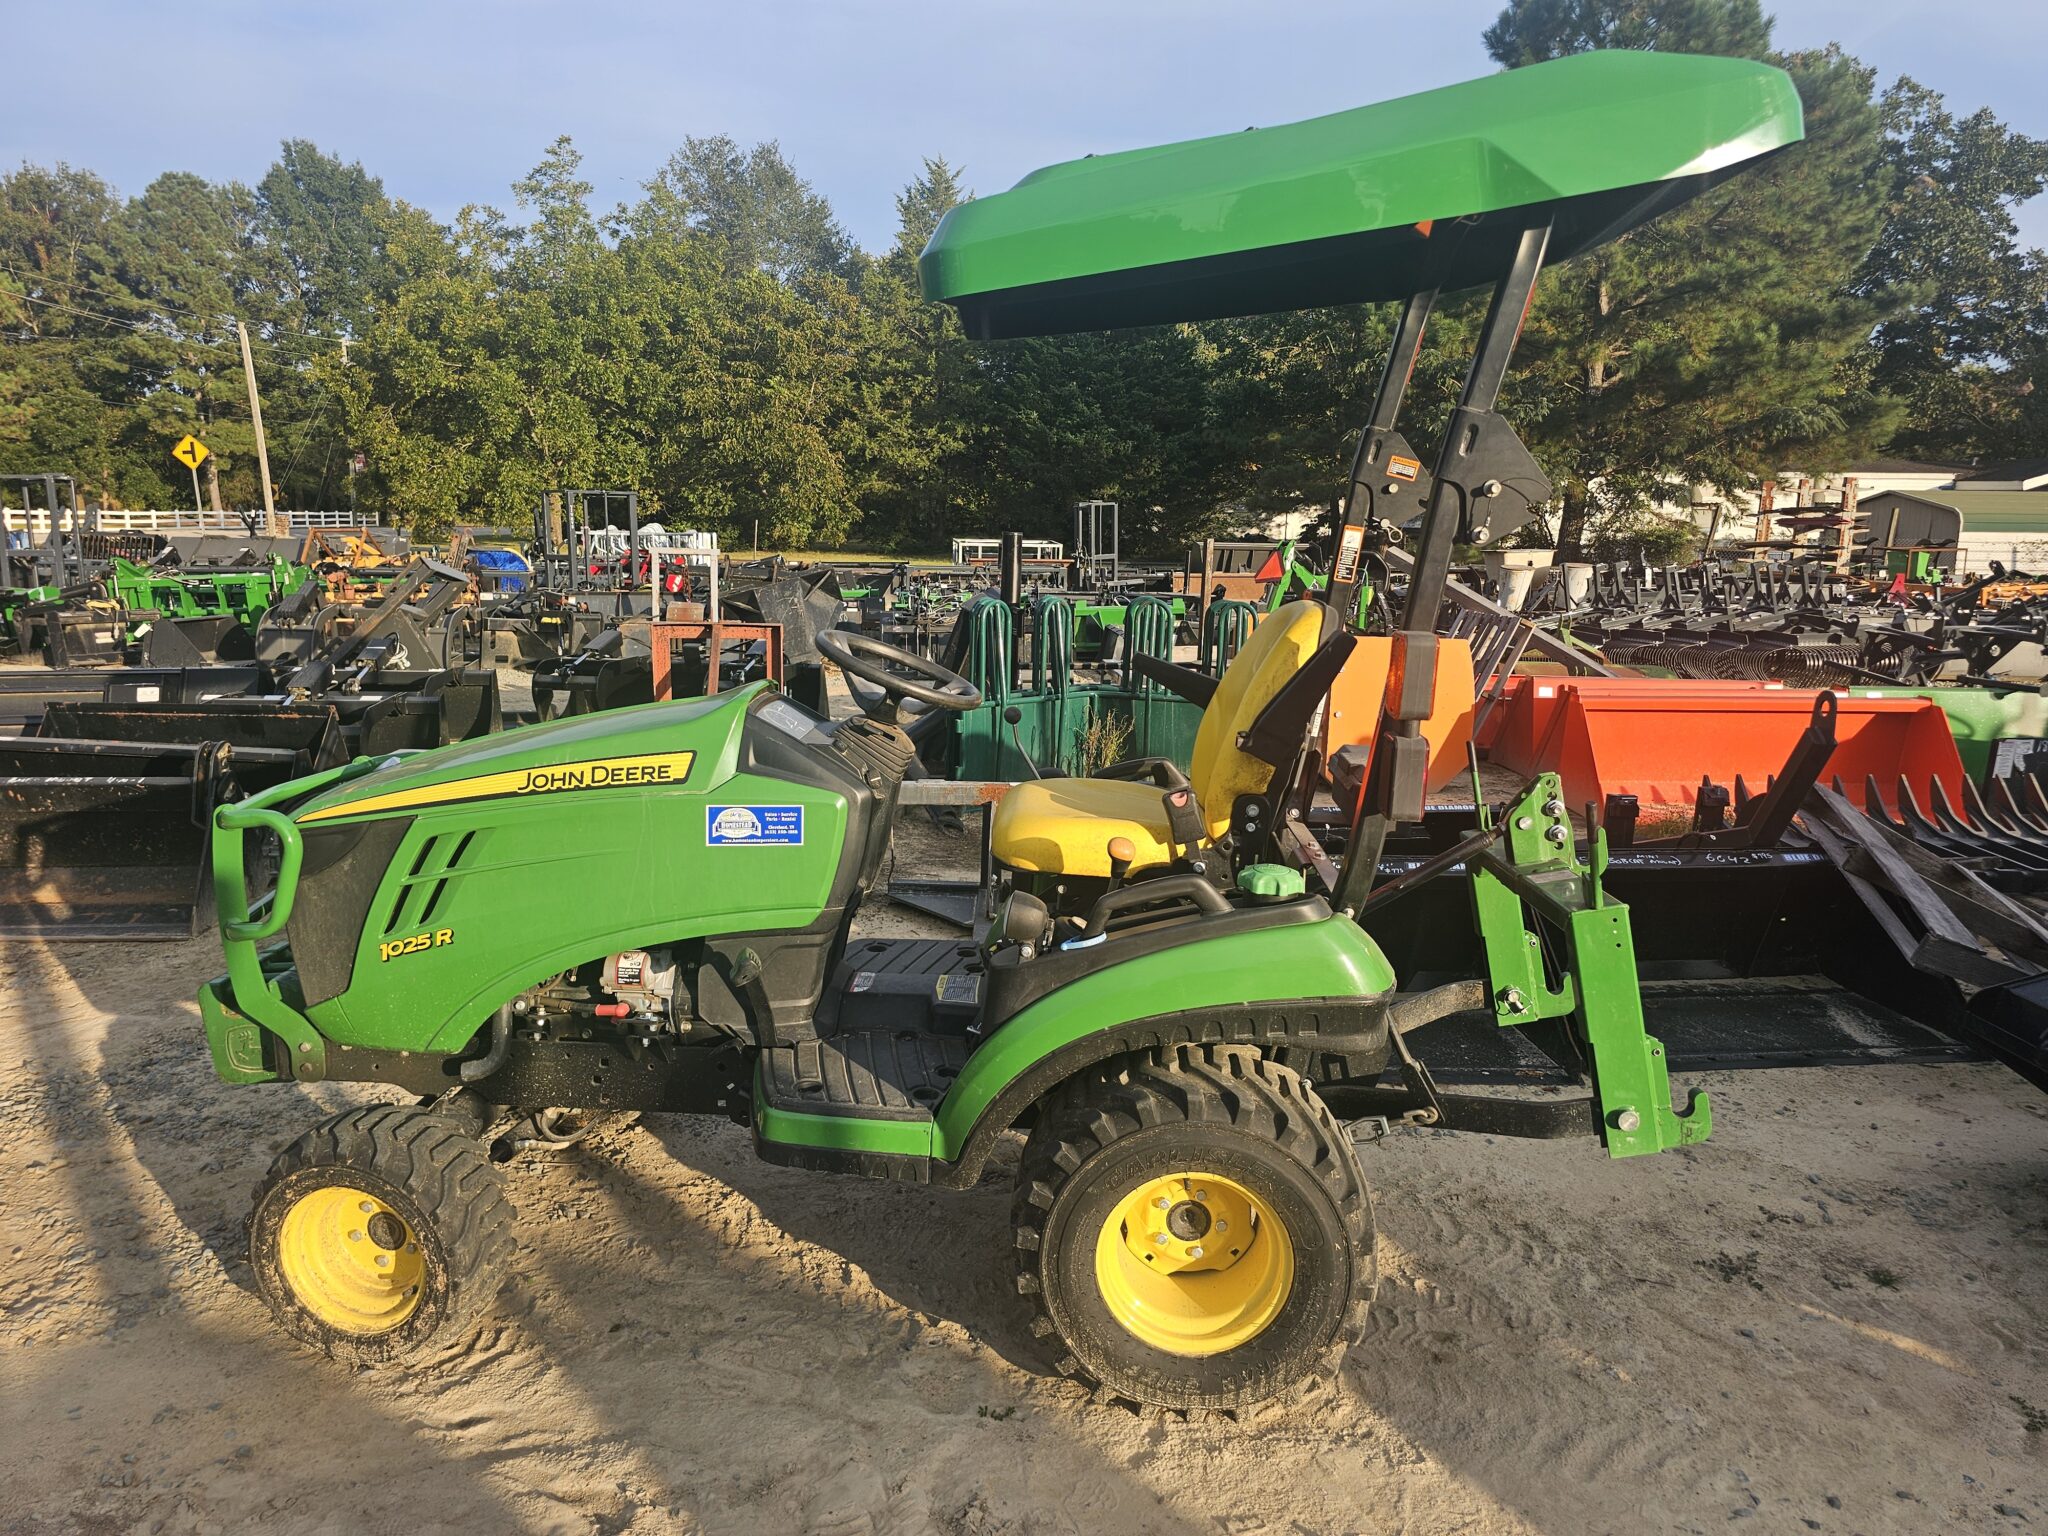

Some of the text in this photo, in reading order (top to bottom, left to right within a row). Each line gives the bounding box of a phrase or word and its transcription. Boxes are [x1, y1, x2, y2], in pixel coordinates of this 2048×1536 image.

[517, 765, 671, 791] JOHN DEERE
[1782, 853, 1811, 862] BLUE
[379, 928, 454, 962] 1025 R
